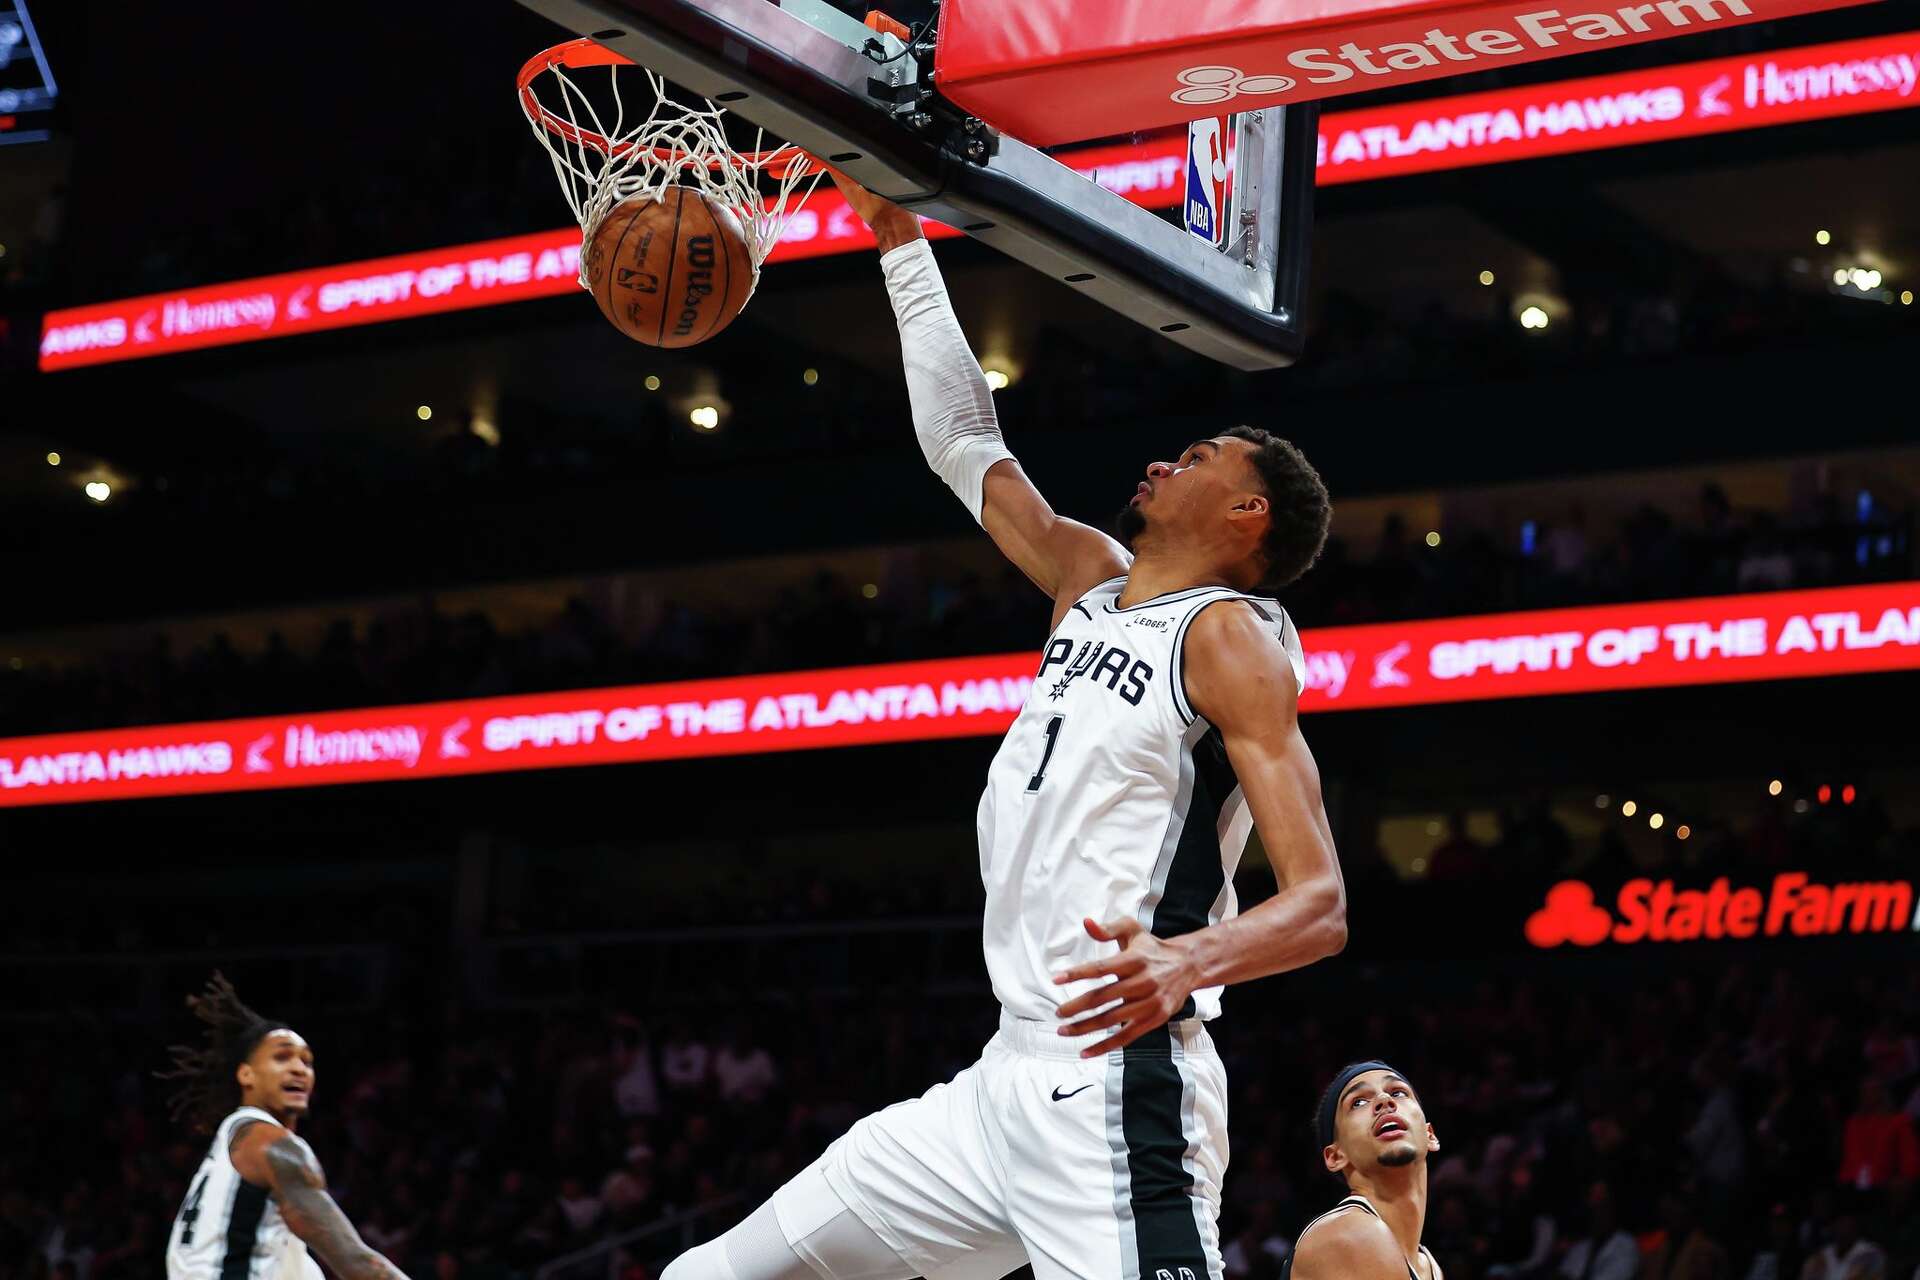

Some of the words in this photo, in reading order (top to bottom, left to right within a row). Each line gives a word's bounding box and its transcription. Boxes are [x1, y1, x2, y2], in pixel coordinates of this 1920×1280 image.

[1331, 111, 1522, 164] ATLANTA
[1524, 86, 1684, 138] HAWKS
[1744, 51, 1920, 109] Hennessy
[1190, 199, 1209, 232] NBA
[317, 270, 414, 313] SPIRIT
[415, 263, 464, 298] OF
[466, 252, 533, 289] THE
[673, 234, 716, 336] Wilson
[1133, 615, 1168, 629] LEDGER
[1428, 631, 1584, 680] SPIRIT
[1586, 625, 1660, 667] OF
[1663, 617, 1768, 661] THE
[107, 741, 233, 780] HAWKS
[482, 709, 602, 752] SPIRIT
[603, 705, 661, 742] OF
[663, 698, 747, 738] THE
[749, 683, 939, 732] ATLANTA
[1025, 713, 1066, 795] 1
